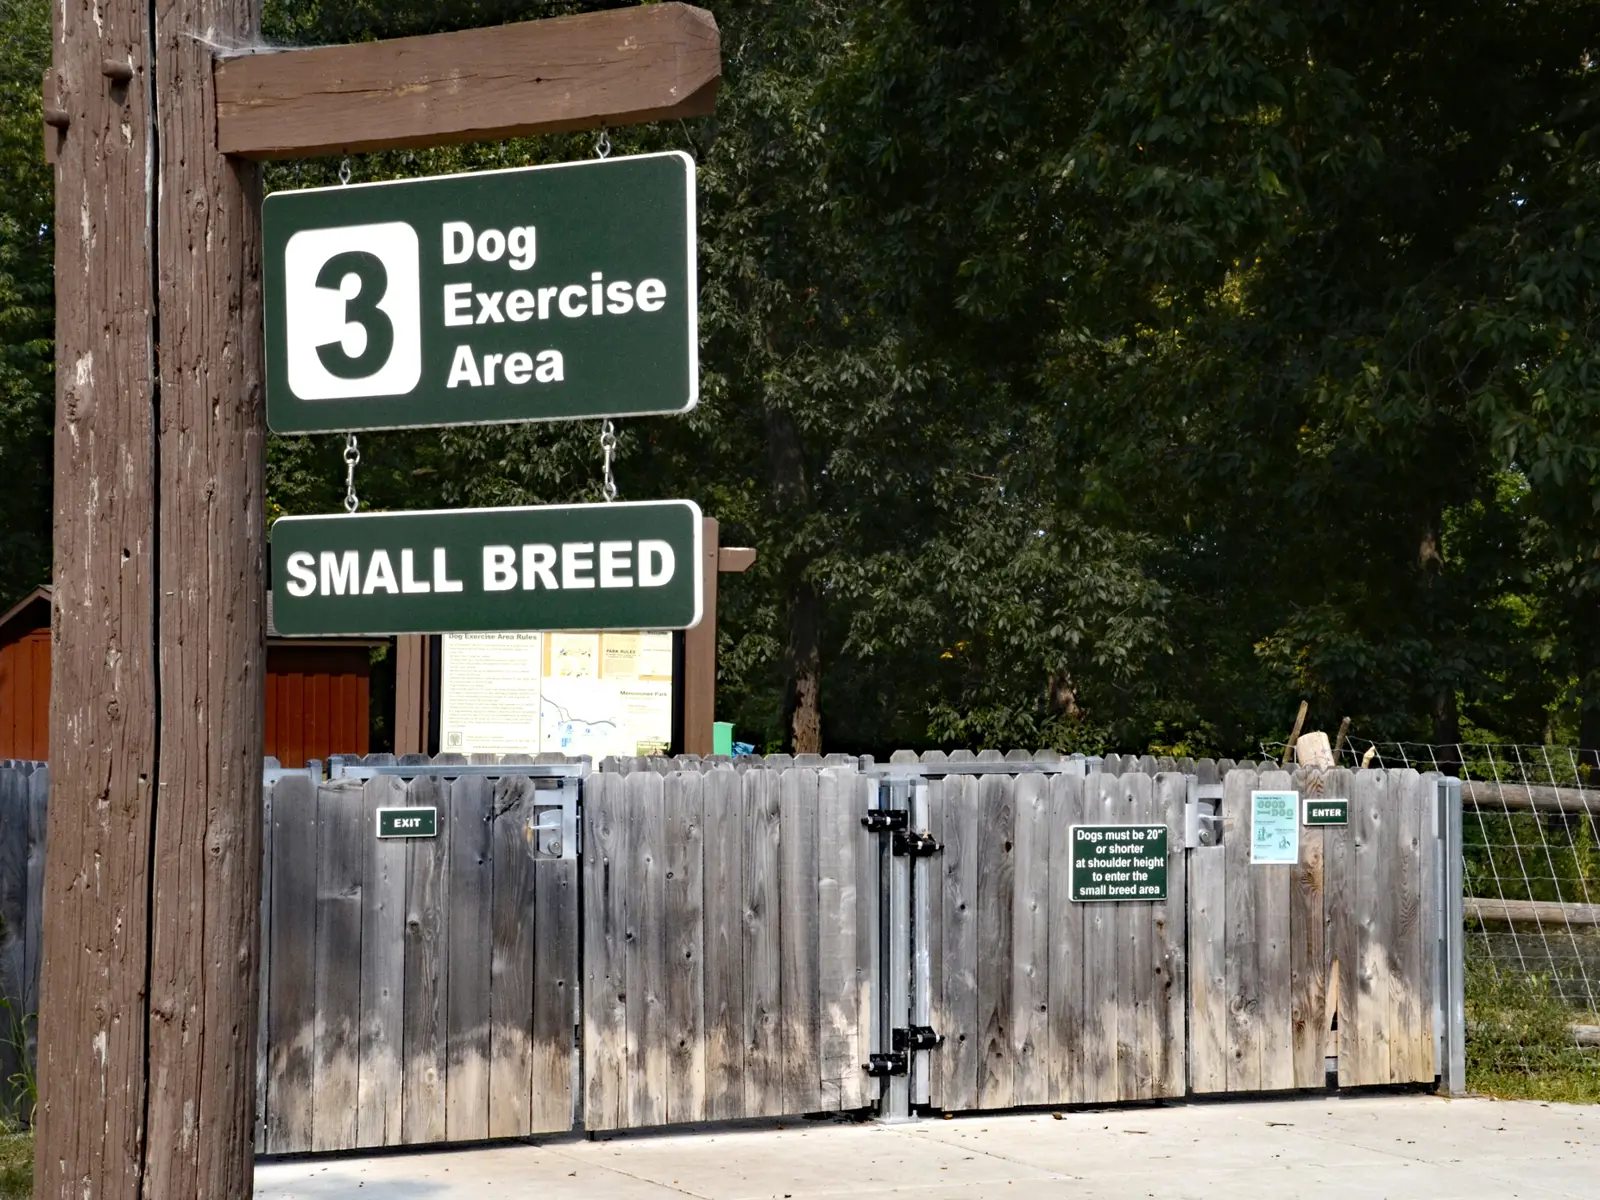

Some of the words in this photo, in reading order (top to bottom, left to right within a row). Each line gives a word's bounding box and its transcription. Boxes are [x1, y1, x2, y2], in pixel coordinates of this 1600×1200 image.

[442, 221, 537, 271] Dog
[444, 272, 667, 327] Exercise
[315, 251, 394, 380] 3
[446, 345, 564, 388] Area
[286, 547, 463, 597] SMALL
[483, 540, 676, 592] BREED
[448, 633, 463, 641] Dog
[1257, 801, 1286, 809] GOOD
[1271, 808, 1294, 816] DOG
[1312, 808, 1342, 818] ENTER
[394, 818, 421, 828] EXIT
[1077, 830, 1103, 843] Dogs
[1105, 831, 1130, 840] must
[1132, 830, 1144, 840] be
[1147, 829, 1163, 840] 20"
[1096, 846, 1107, 854] or
[1109, 844, 1144, 854] shorter
[1076, 859, 1085, 868] at
[1088, 857, 1133, 868] shoulder
[1133, 857, 1164, 870] height
[1092, 872, 1102, 881] to
[1105, 872, 1130, 881] enter
[1132, 871, 1148, 881] the
[1079, 885, 1106, 895] small
[1109, 884, 1137, 895] breed
[1139, 886, 1160, 894] area
